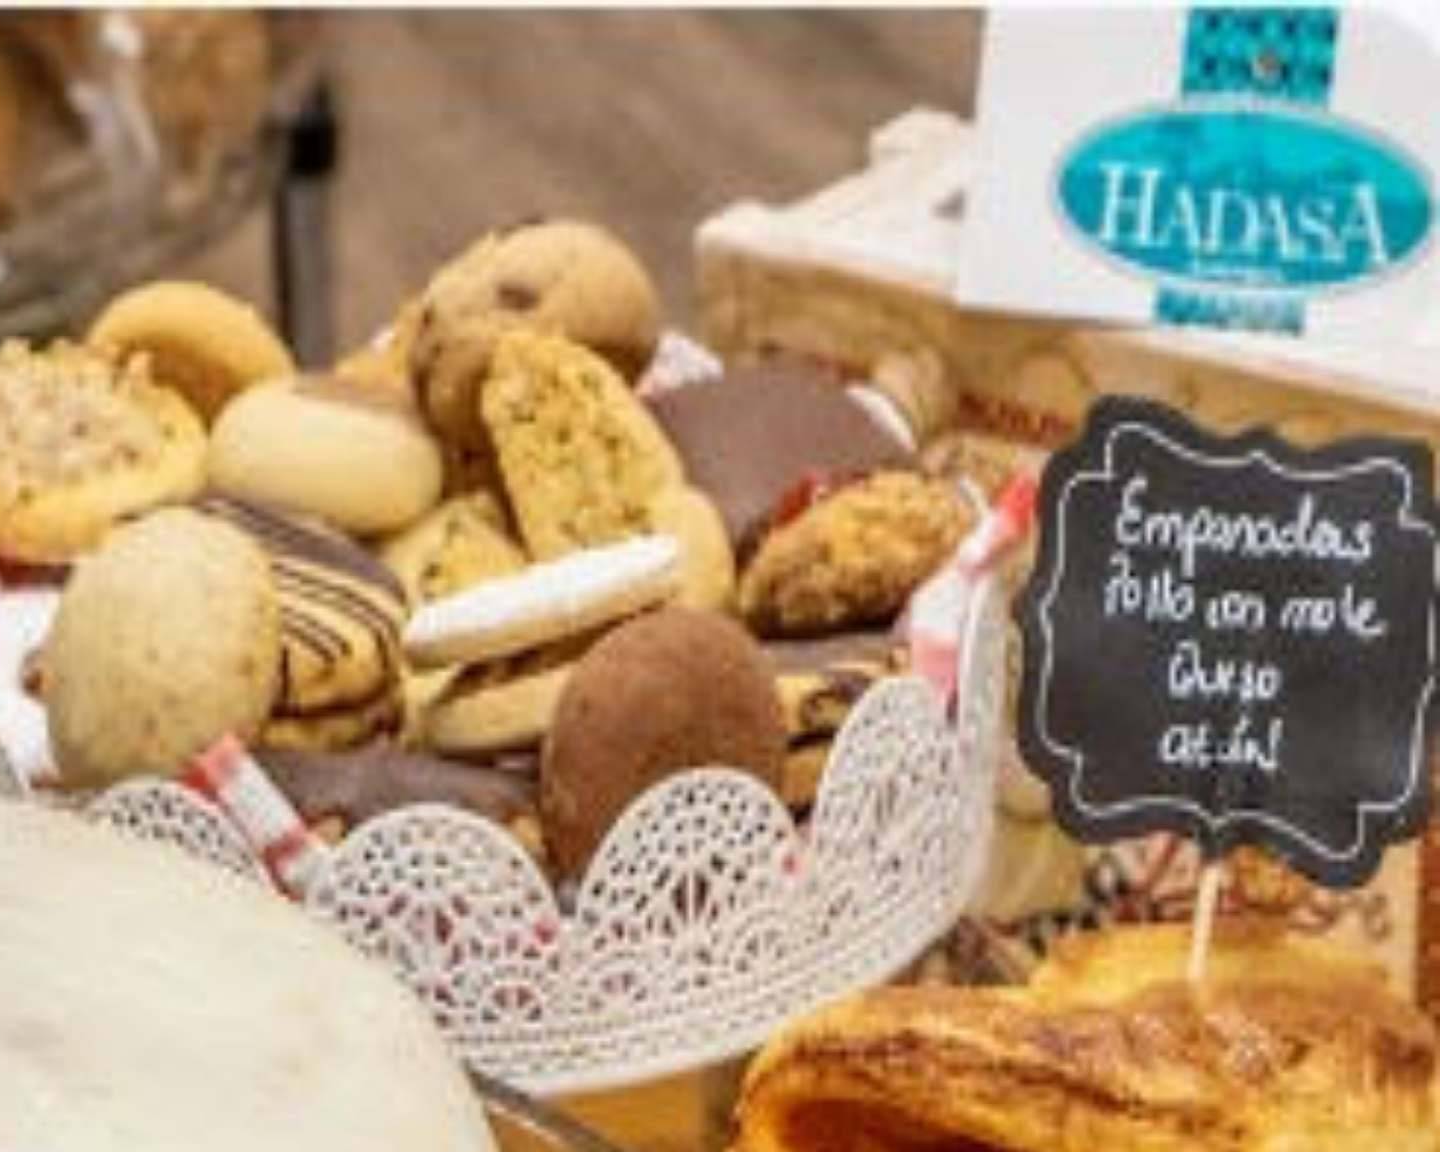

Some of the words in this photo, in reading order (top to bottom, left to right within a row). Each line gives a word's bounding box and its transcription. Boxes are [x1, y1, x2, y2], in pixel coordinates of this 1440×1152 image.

[1098, 161, 1388, 264] HADASA
[1116, 473, 1375, 576] Empanadas
[1279, 582, 1389, 638] mole
